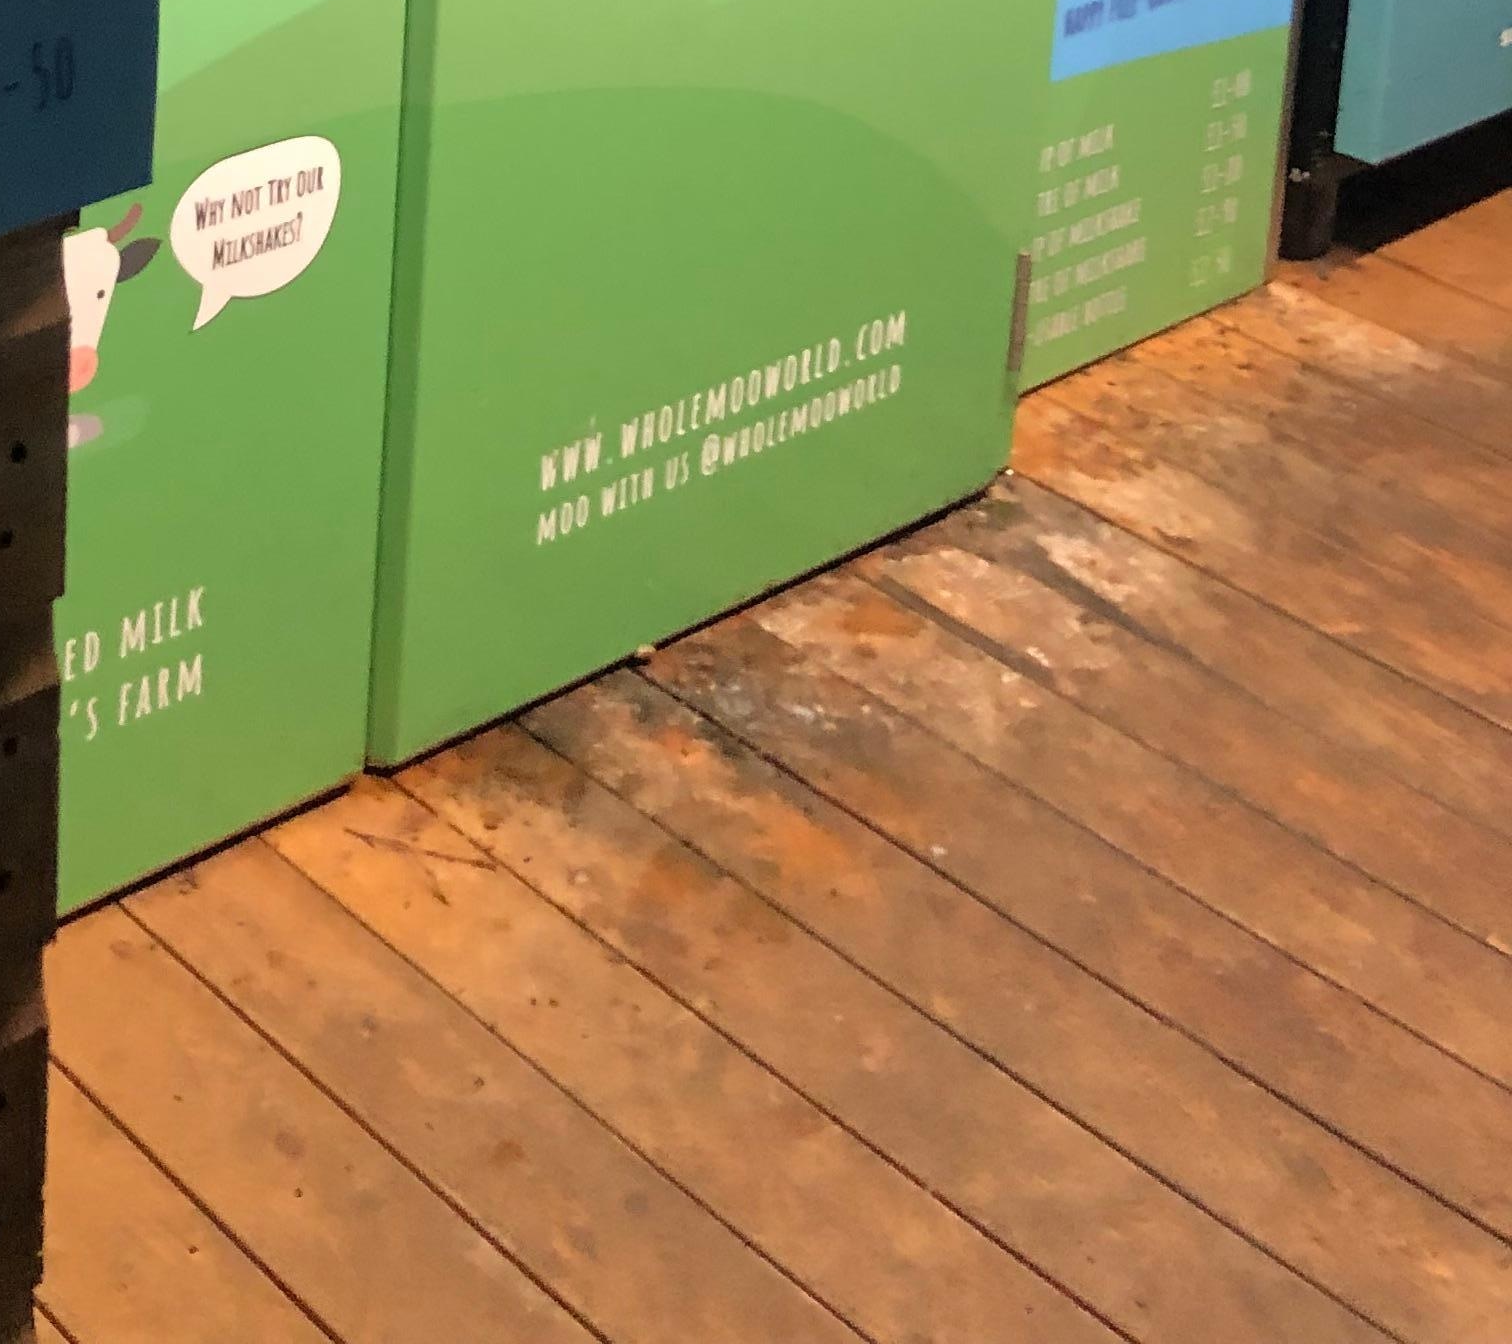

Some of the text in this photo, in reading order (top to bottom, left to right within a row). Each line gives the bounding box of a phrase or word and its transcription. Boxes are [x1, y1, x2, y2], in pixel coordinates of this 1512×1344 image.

[194, 166, 324, 232] WHY NOT TRY OUR
[212, 210, 304, 271] MILKSHAKES?
[537, 364, 901, 546] MOO WITH US @WHOLEMOOWORLD
[64, 585, 206, 681] ED MILK
[118, 653, 204, 726] FARM
